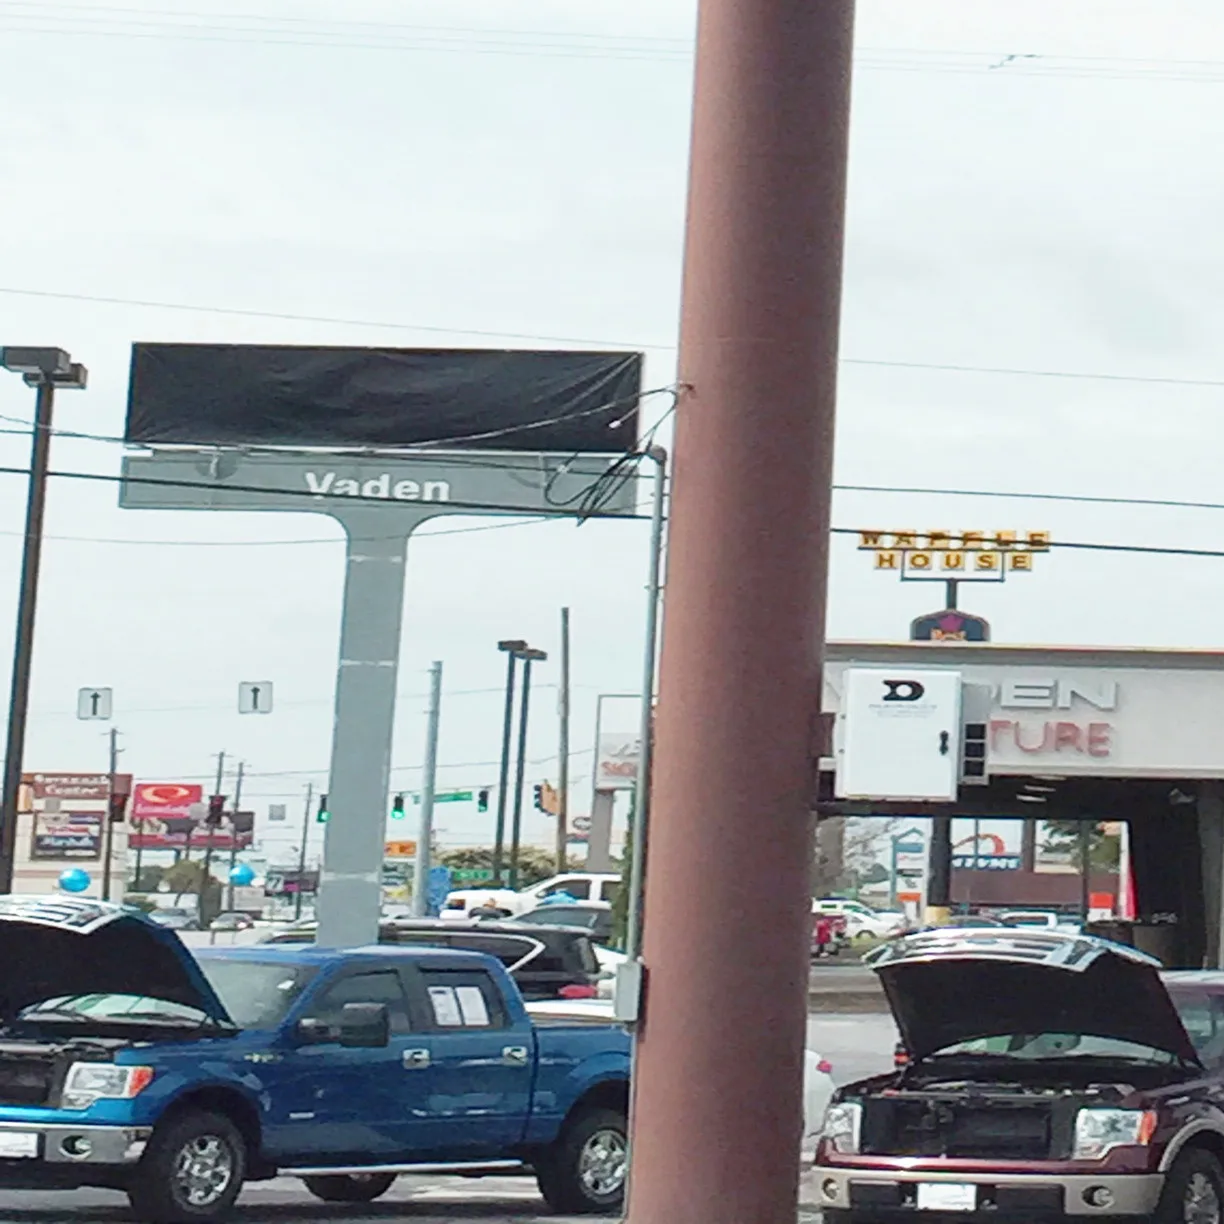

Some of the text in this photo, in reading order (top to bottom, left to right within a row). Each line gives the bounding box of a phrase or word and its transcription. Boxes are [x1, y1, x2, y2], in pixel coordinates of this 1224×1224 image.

[304, 472, 450, 501] Vaden
[862, 530, 1046, 548] WAFFLE
[878, 553, 1028, 570] HOUSE
